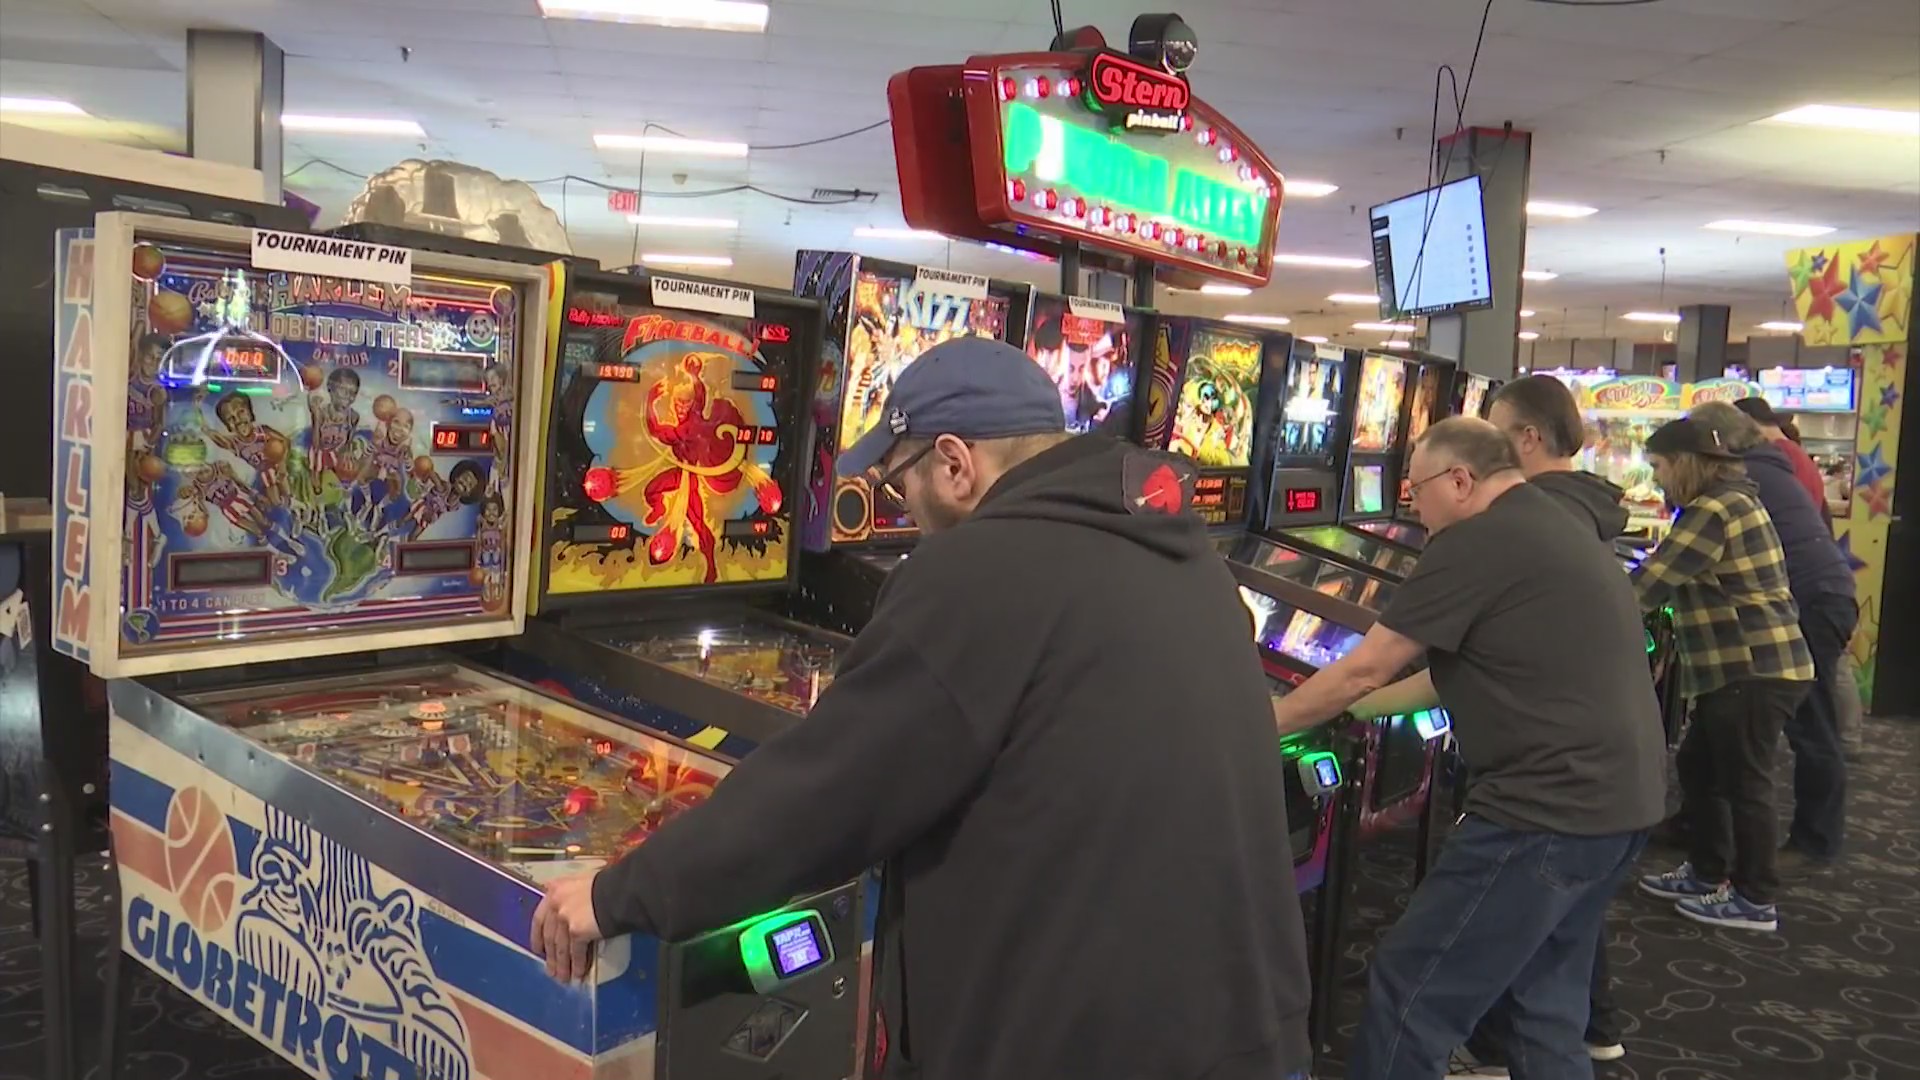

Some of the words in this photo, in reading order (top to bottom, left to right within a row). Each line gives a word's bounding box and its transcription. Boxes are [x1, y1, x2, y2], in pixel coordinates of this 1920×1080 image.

[1101, 66, 1182, 109] Stern
[1126, 109, 1182, 129] pinball
[257, 231, 376, 261] TOURNAMENT
[377, 249, 407, 265] PIN
[918, 267, 972, 287] TOURNAMENT
[972, 277, 987, 288] PIN
[654, 279, 732, 299] TOURNAMENT
[732, 289, 752, 302] PIN
[1070, 297, 1110, 312] TOURNAMENT
[1110, 303, 1121, 313] PIN
[312, 349, 330, 361] ON
[335, 350, 369, 366] TOUR
[387, 360, 398, 377] 2
[761, 378, 776, 389] 00
[57, 238, 94, 643] HARLEM
[436, 431, 456, 445] 00
[610, 526, 627, 538] 00
[276, 559, 288, 576] 3
[170, 599, 187, 611] TO
[191, 598, 199, 609] 4
[205, 597, 231, 609] CAN
